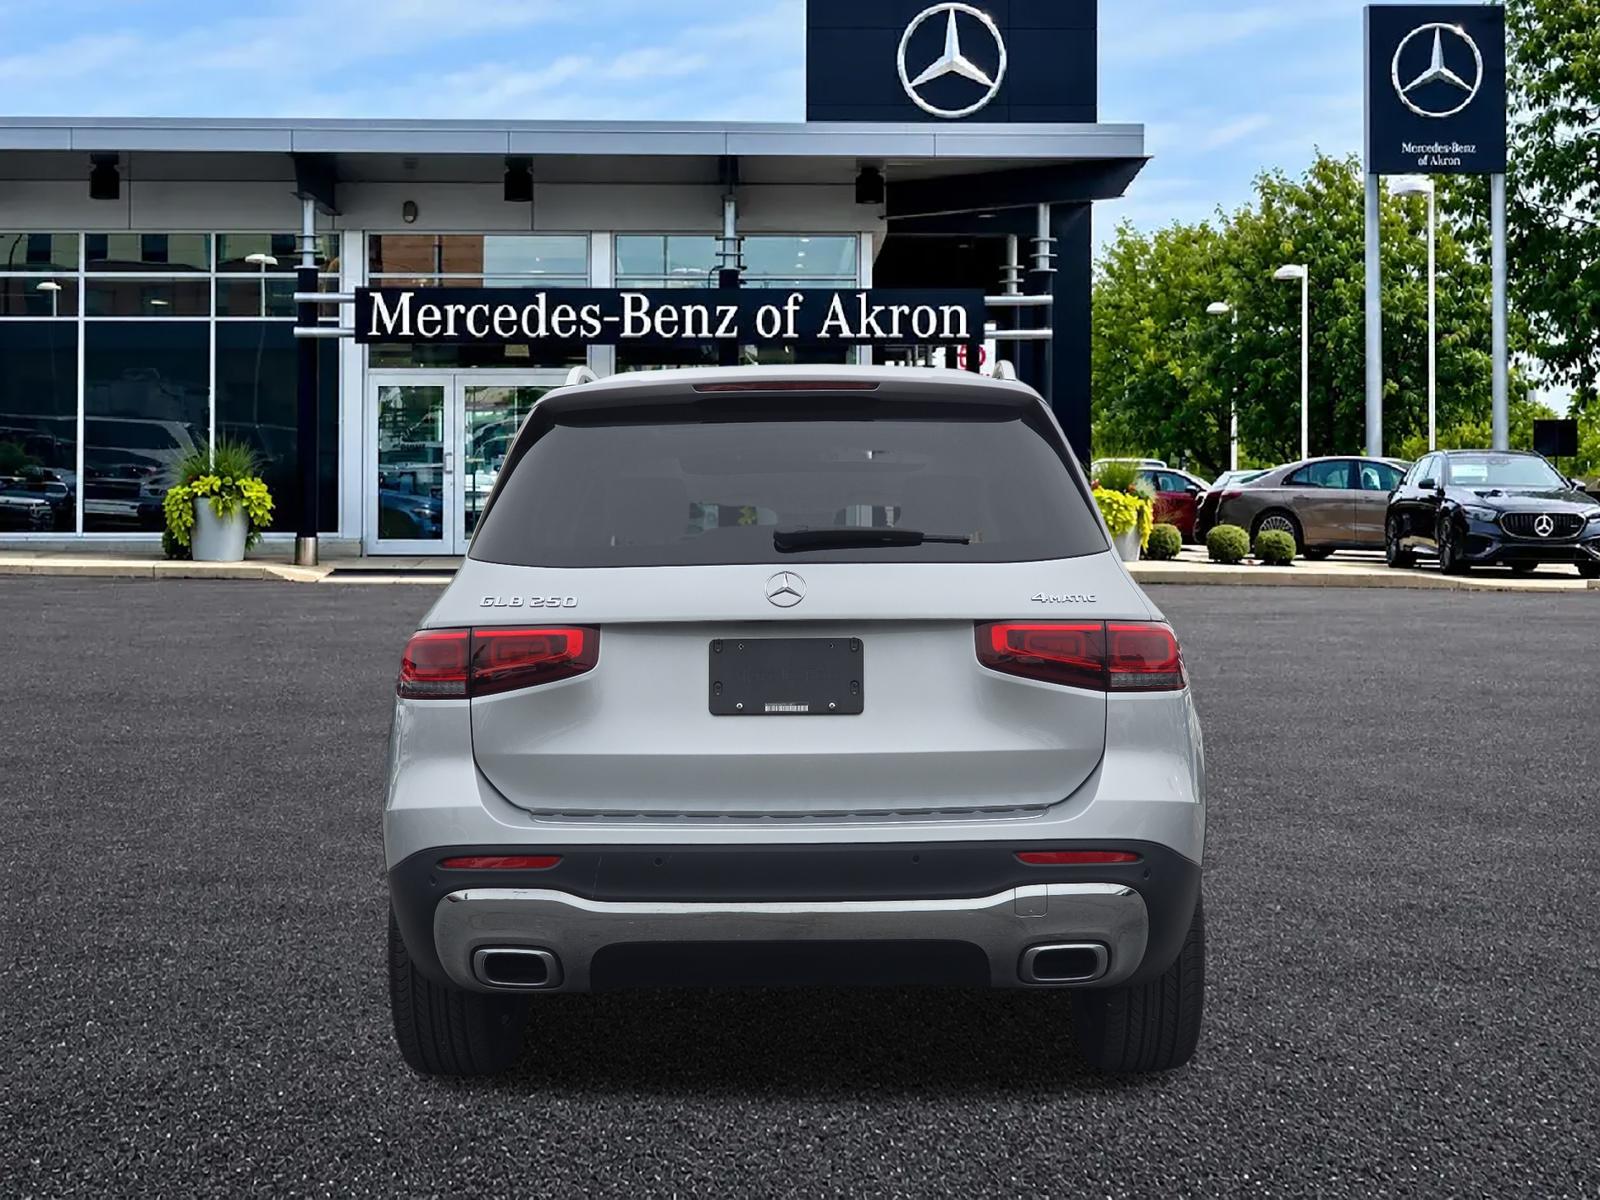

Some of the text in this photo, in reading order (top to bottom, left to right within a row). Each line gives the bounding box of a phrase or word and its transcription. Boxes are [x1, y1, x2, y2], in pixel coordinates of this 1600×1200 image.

[1401, 142, 1477, 154] Mercedes-Benz
[1417, 154, 1461, 166] of Akron
[367, 291, 970, 338] Mercedes-Benz of Akron
[479, 595, 579, 608] GLB 250
